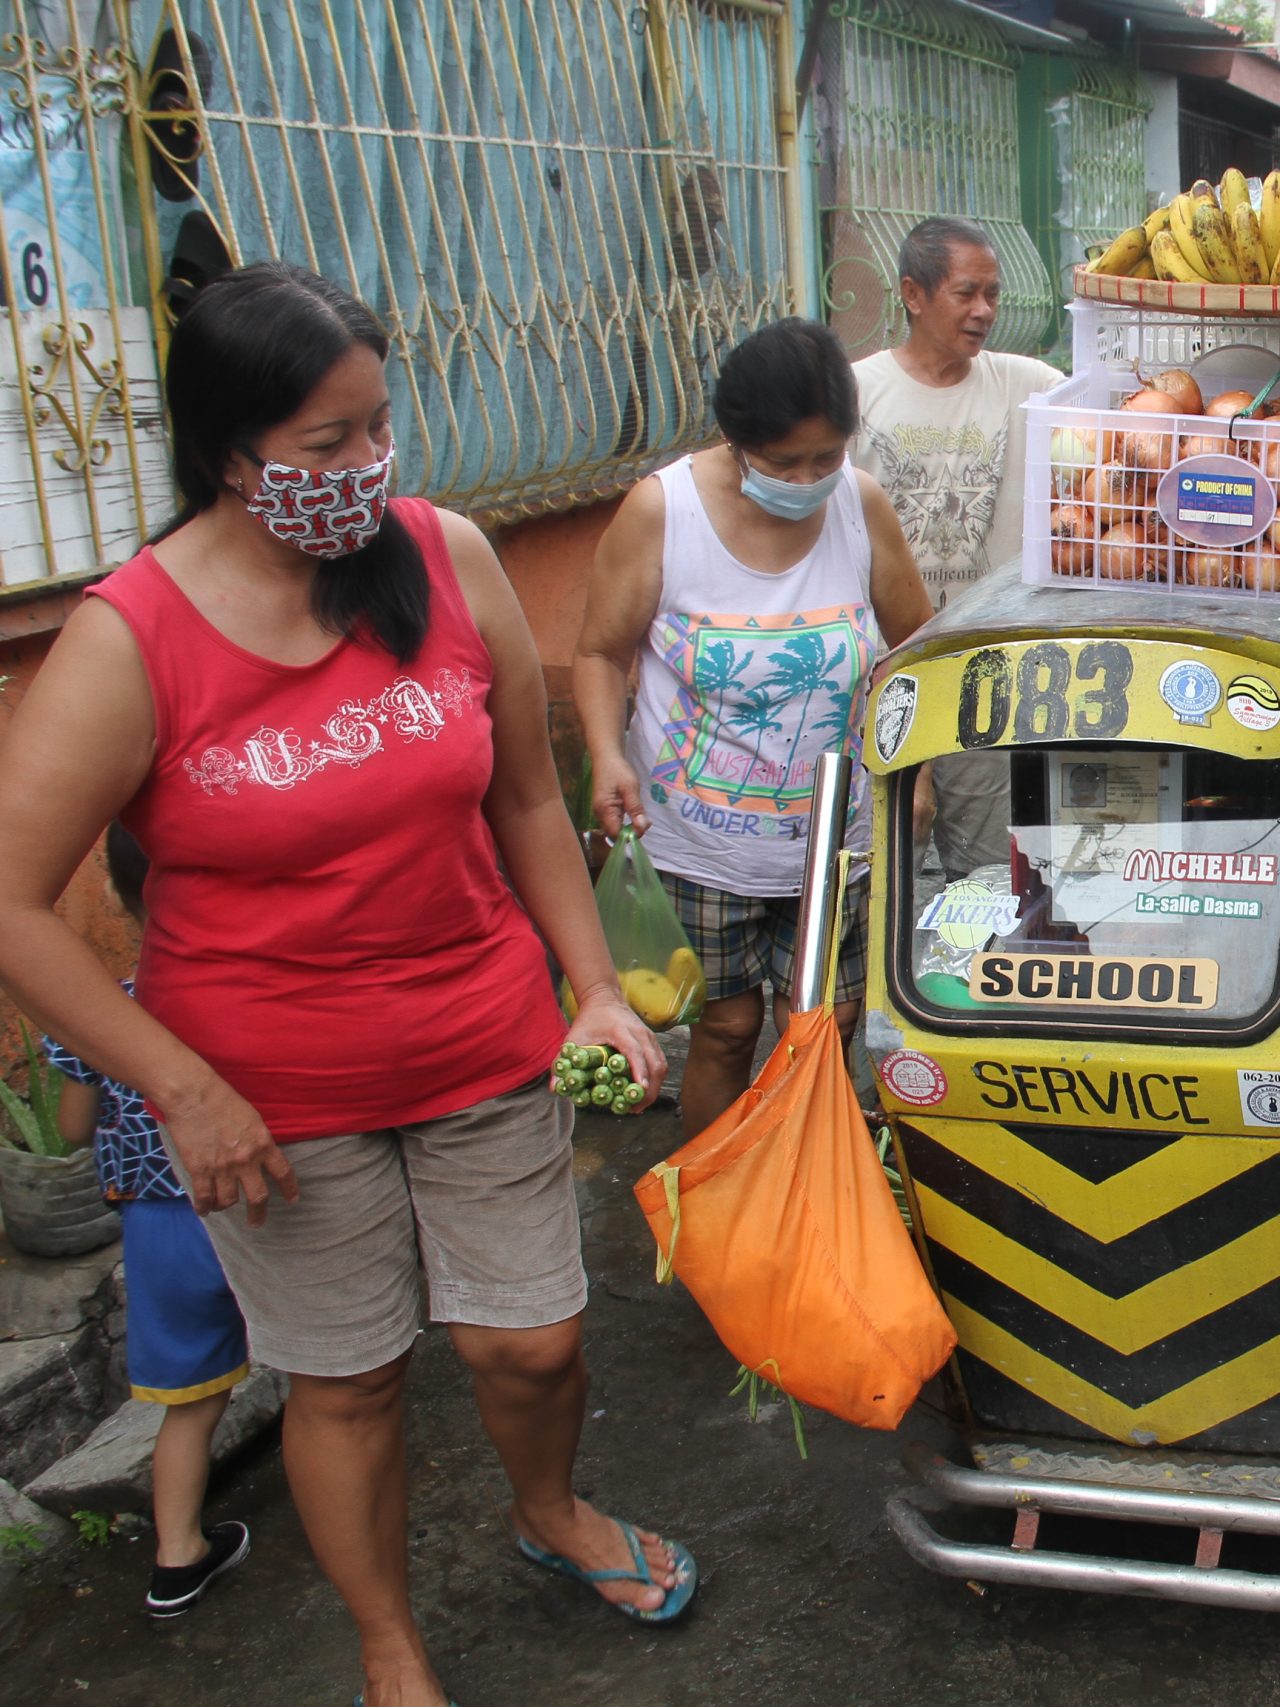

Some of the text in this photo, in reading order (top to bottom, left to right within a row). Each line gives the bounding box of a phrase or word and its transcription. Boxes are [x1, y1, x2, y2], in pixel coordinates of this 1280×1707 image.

[1196, 481, 1252, 496] PRODUCT OF CHINA
[957, 641, 1134, 749] 083
[705, 749, 806, 786] AUSTRALIA
[680, 798, 761, 836] UNDER
[1124, 849, 1276, 883] MICHELLE
[923, 894, 1015, 929] LAKERS
[1137, 894, 1259, 916] La-salle Dasma
[980, 958, 1202, 1004] SCHOOL
[883, 1051, 903, 1073] MOLINO
[905, 1051, 935, 1068] HOMES
[971, 1060, 1210, 1124] SERVICE
